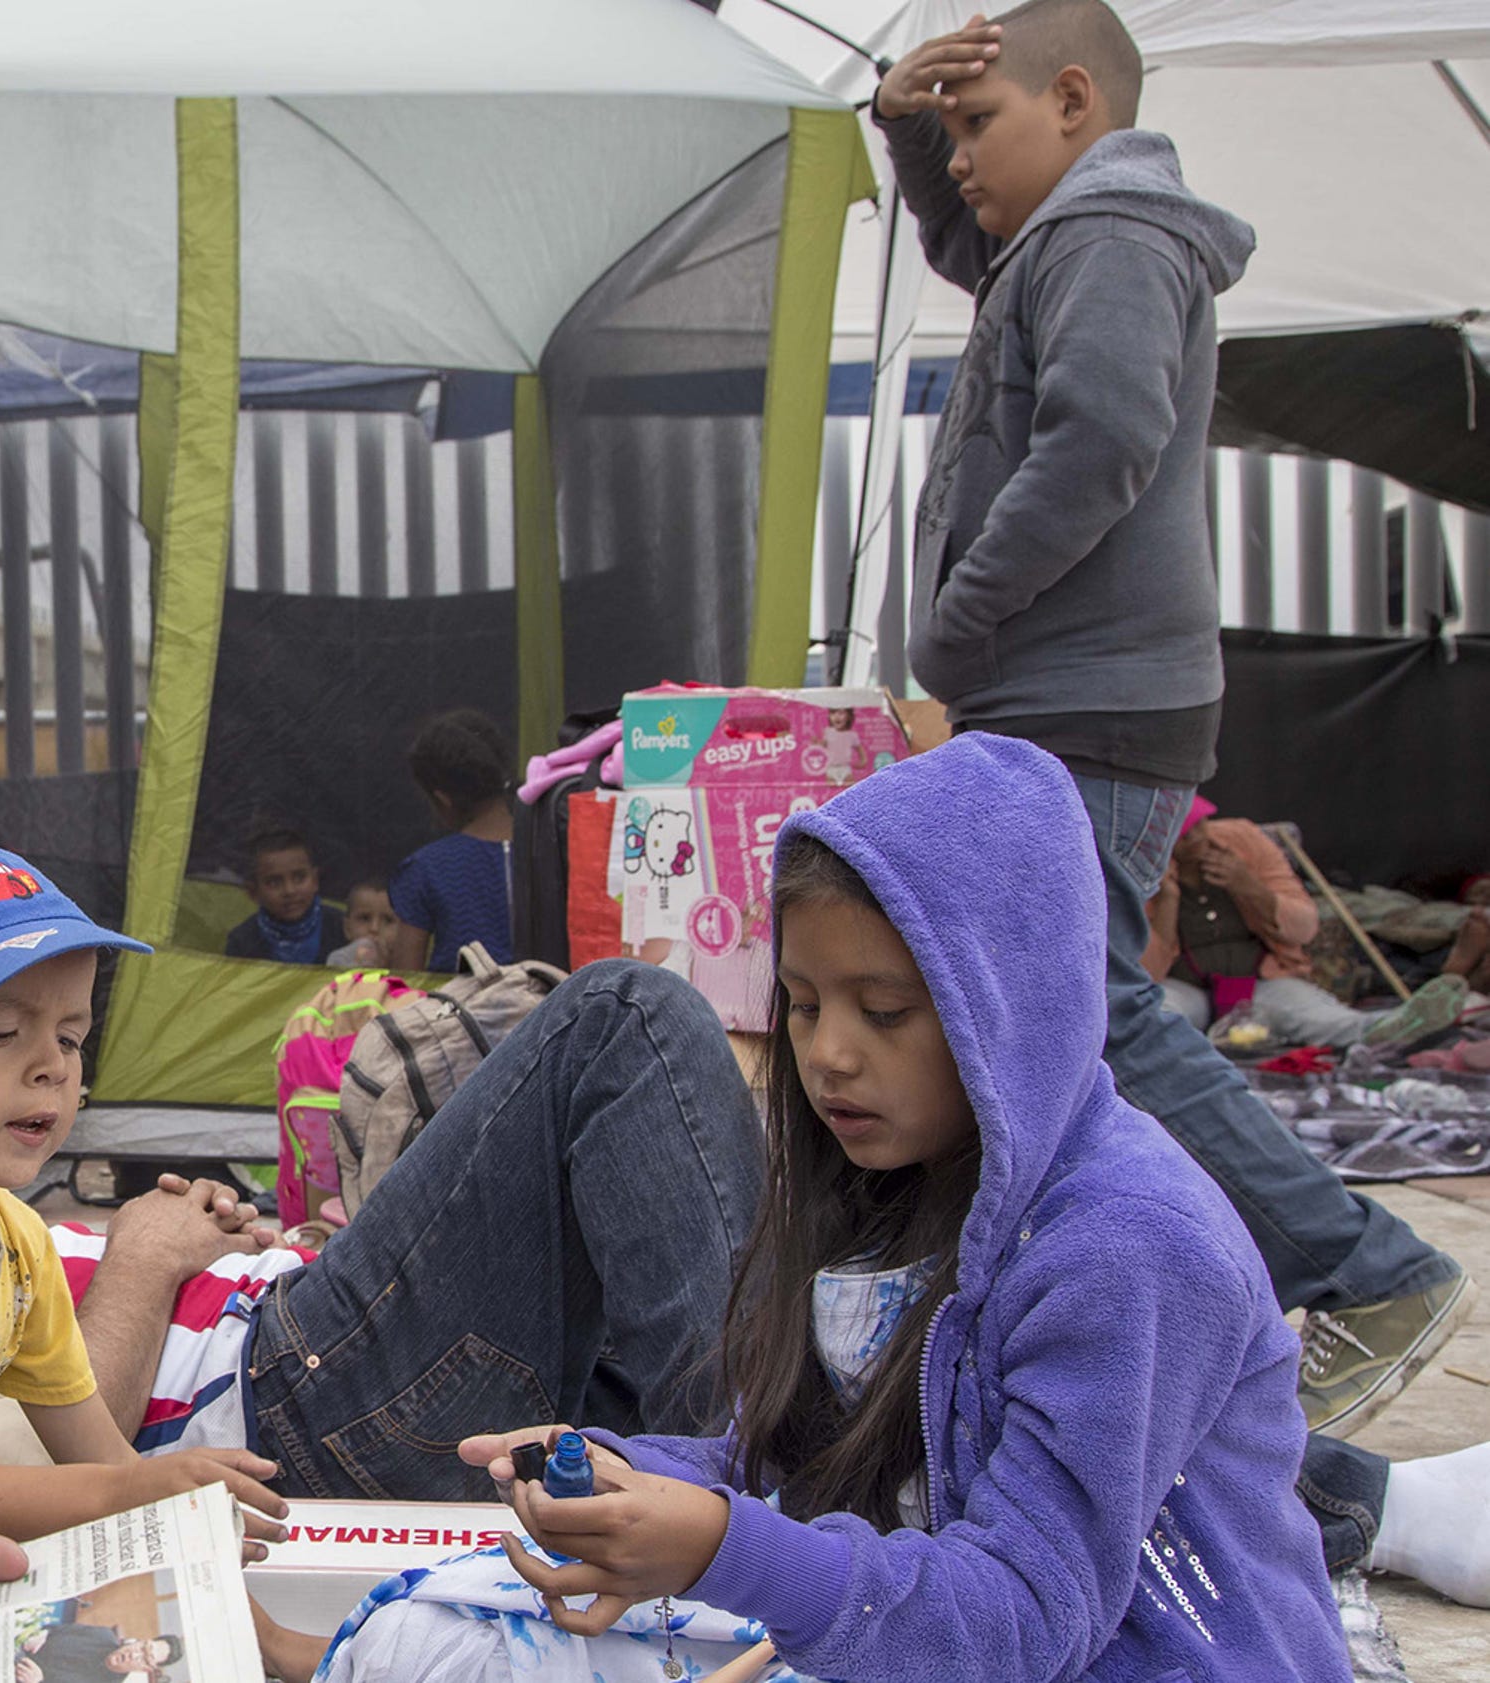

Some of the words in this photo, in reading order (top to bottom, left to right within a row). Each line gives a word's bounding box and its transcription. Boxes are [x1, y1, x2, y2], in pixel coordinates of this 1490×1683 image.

[631, 727, 691, 752] Pampers
[705, 741, 753, 764] easy
[756, 734, 797, 758] ups
